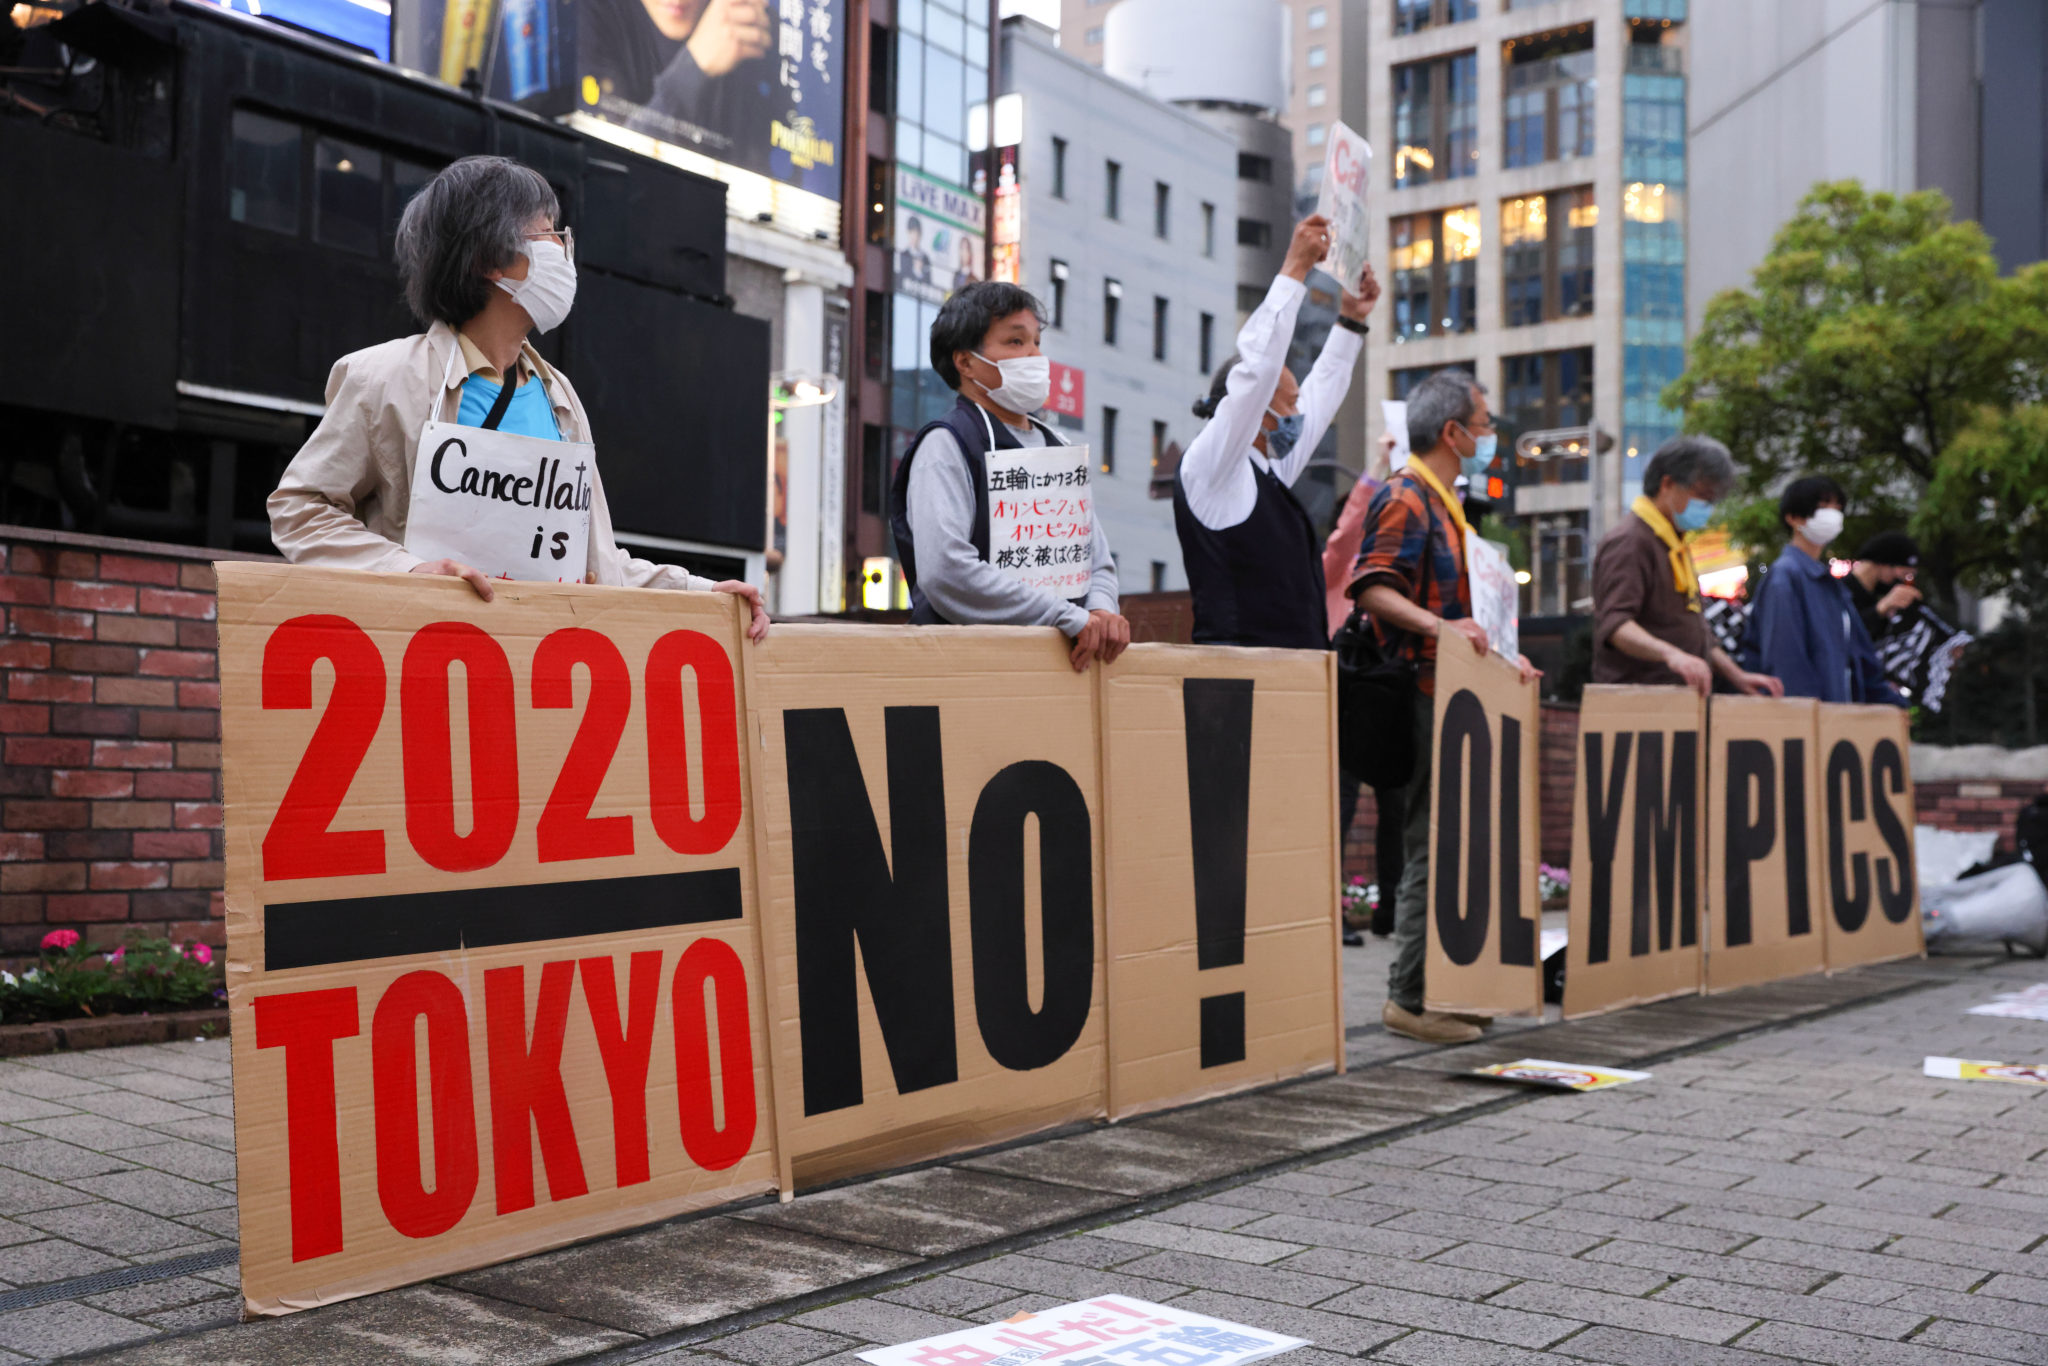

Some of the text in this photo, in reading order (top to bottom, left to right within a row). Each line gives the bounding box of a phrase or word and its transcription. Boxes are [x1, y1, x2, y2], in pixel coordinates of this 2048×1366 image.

[530, 525, 570, 560] is
[262, 613, 742, 881] 2020
[1434, 687, 1914, 967] OLYMPICS
[251, 937, 757, 1264] TOKYO
